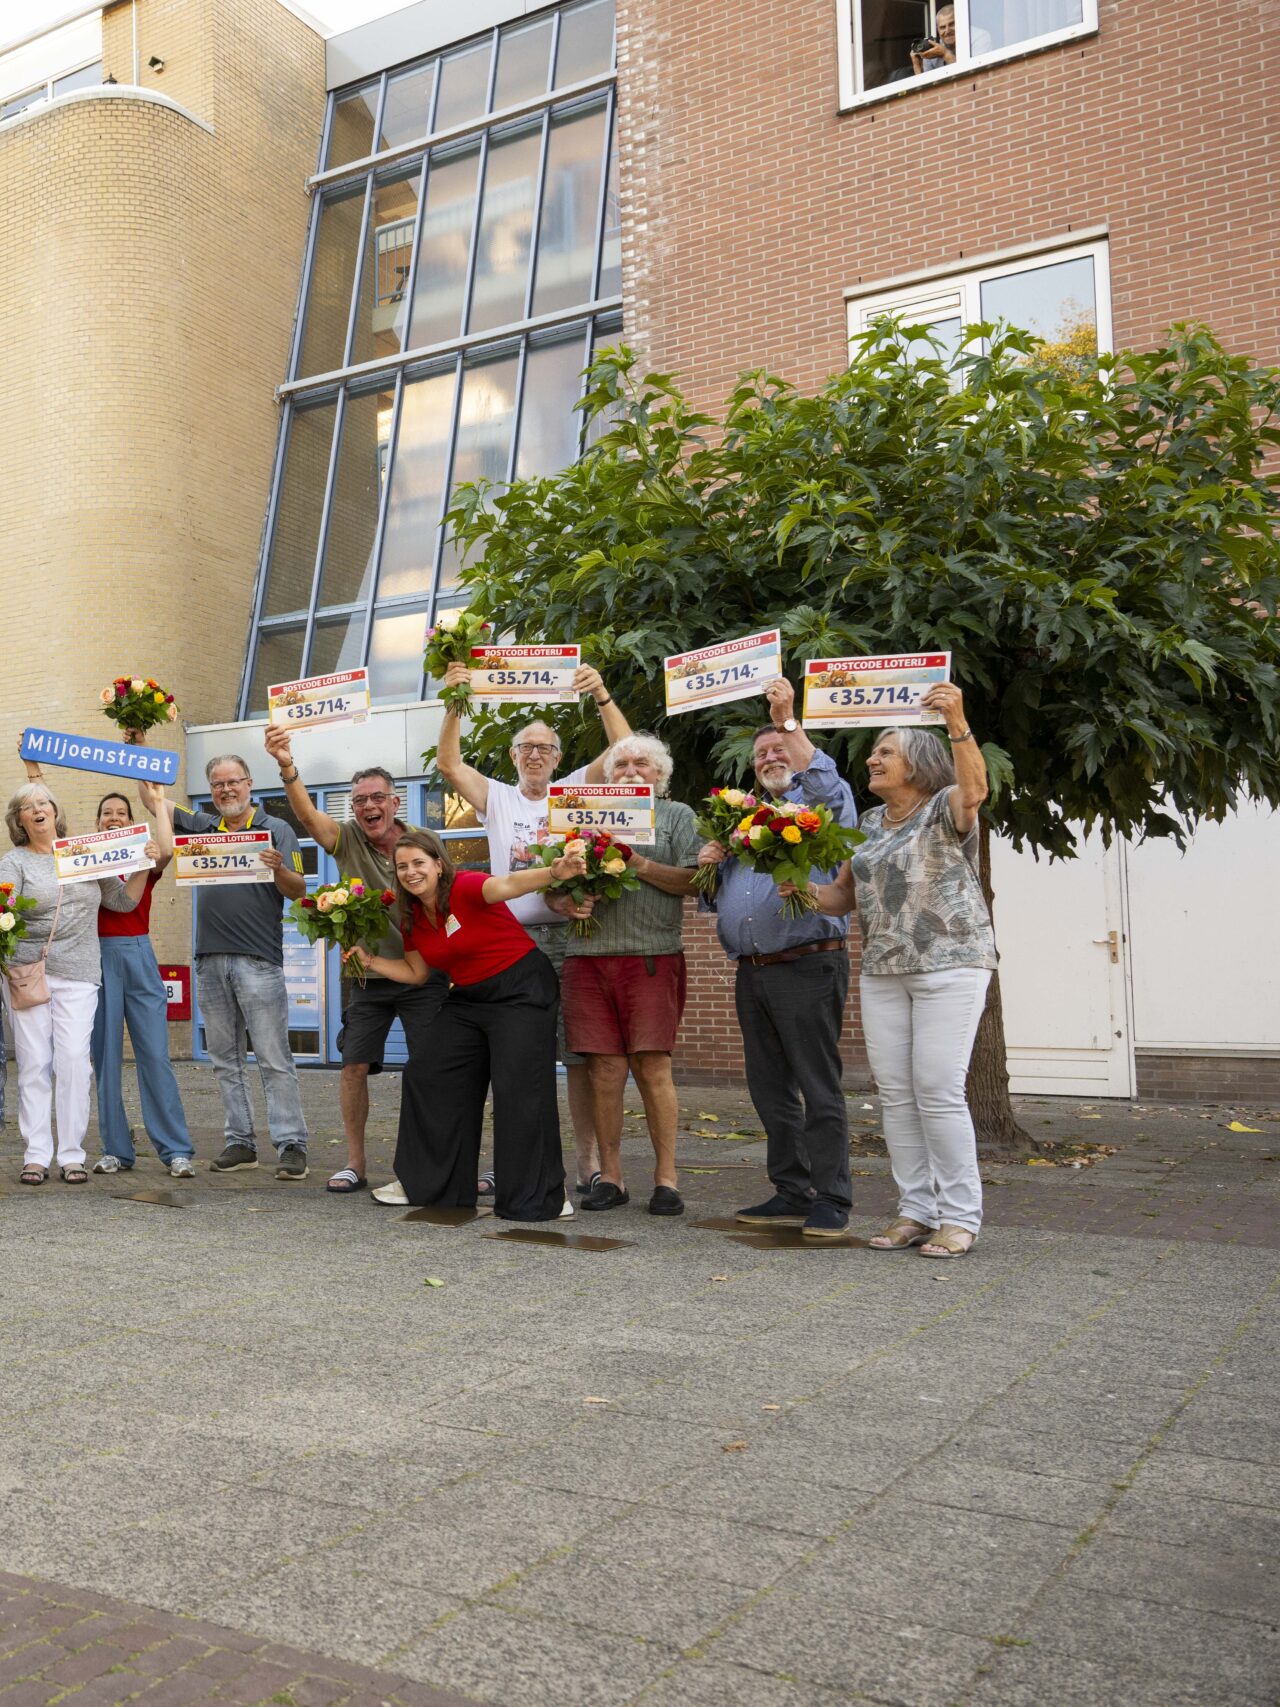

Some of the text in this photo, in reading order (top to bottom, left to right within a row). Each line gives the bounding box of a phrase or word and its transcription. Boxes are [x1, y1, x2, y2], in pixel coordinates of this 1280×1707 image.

[484, 648, 563, 657] POSTCODE LOTERIJ
[681, 637, 761, 665] POSTCODE LOTERIJ
[826, 657, 927, 671] POSTCODE LOTERIJ
[283, 674, 352, 693] POSTCODE LOTERIJ
[27, 733, 172, 773] Miljoenstraat
[68, 829, 134, 846] POSTCODE LOTERIJ
[188, 834, 256, 845] POSTCODE LOTERIJ
